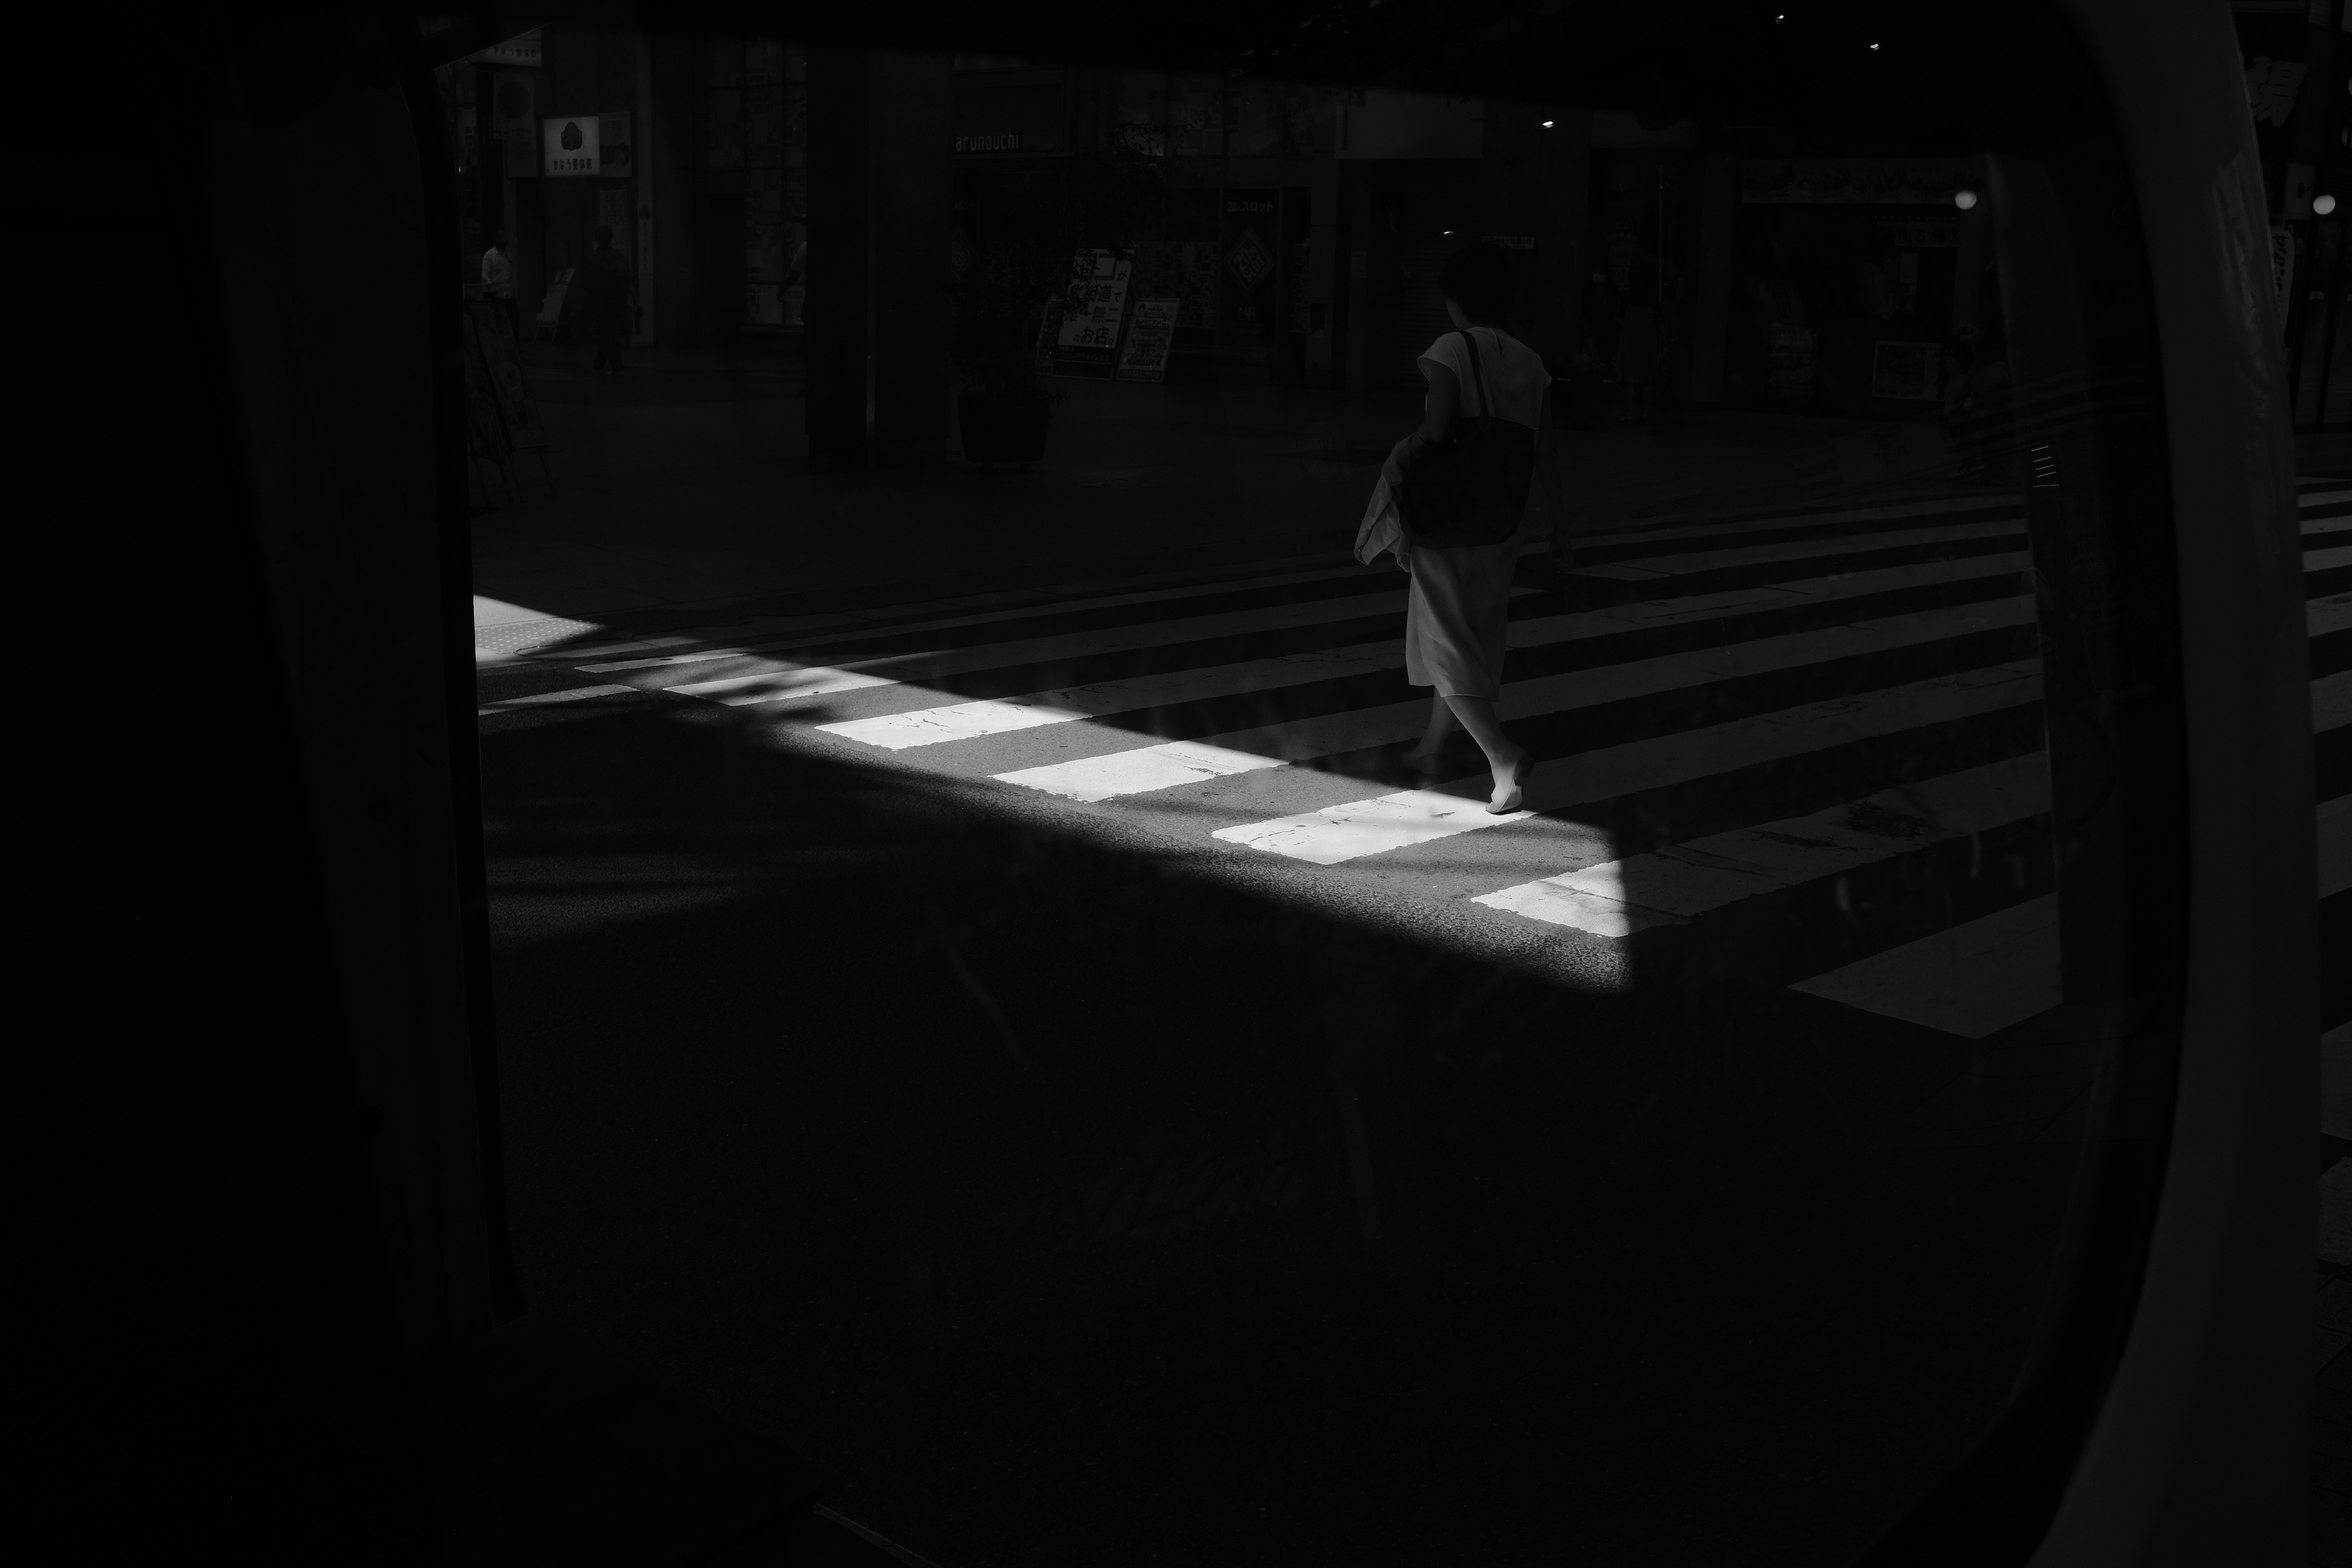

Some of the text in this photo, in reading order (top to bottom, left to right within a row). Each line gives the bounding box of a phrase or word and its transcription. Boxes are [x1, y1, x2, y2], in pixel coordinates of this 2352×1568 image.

[1242, 252, 1265, 283] SLOT
[1073, 326, 1114, 345] のお店。
